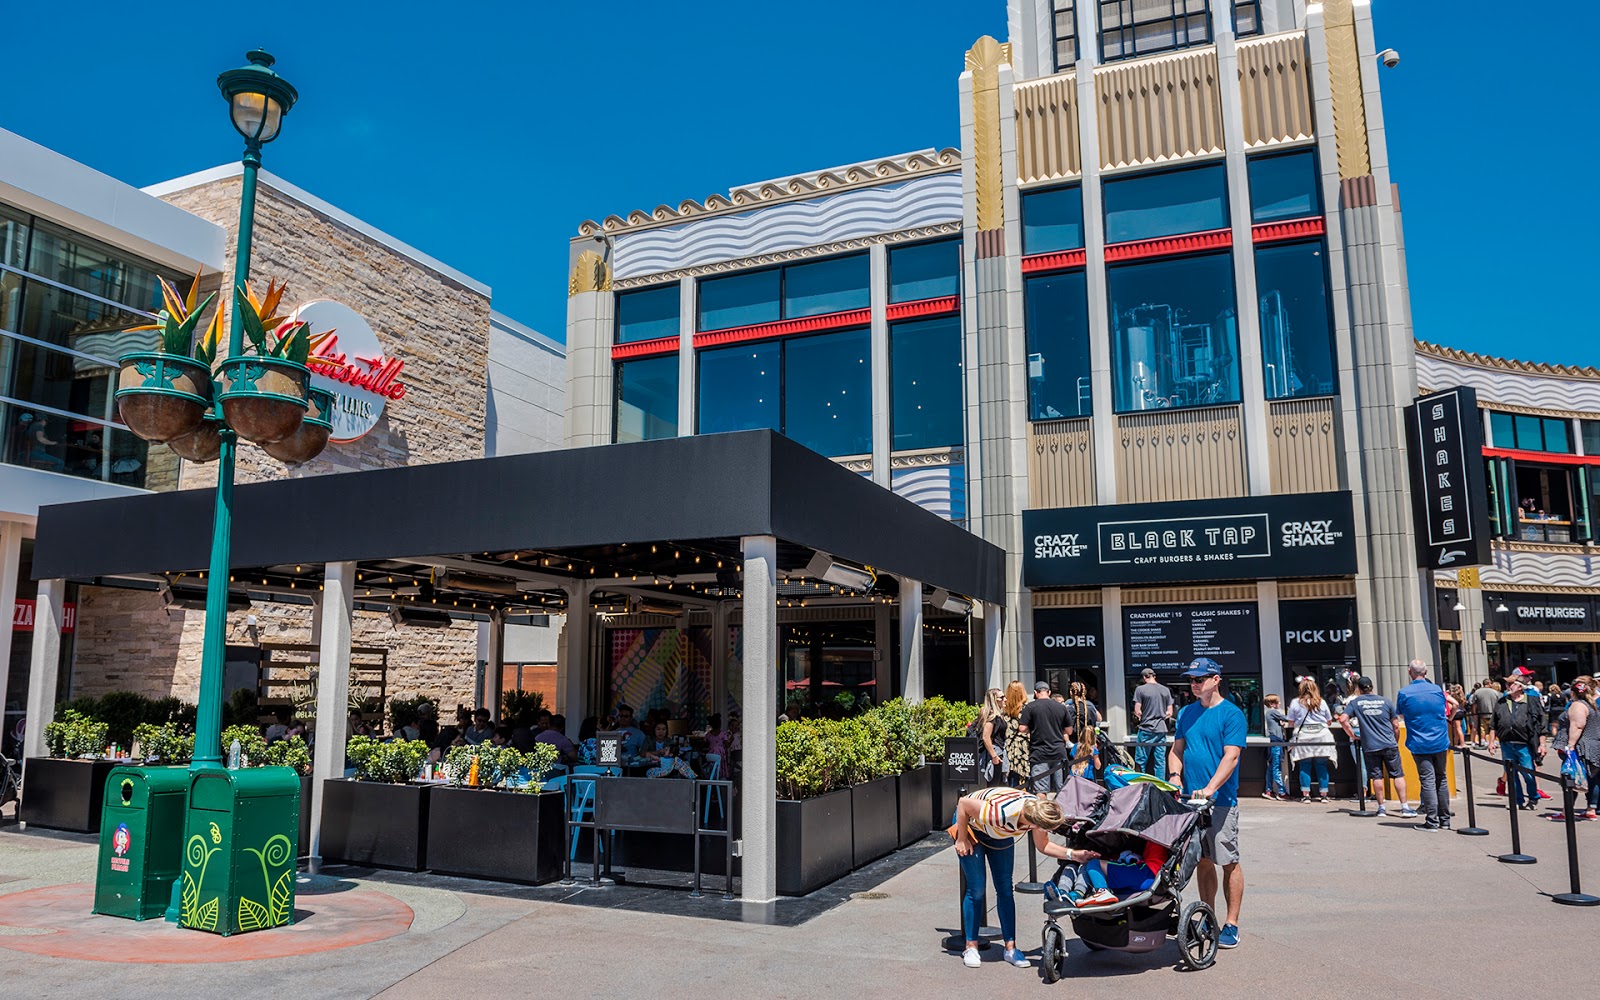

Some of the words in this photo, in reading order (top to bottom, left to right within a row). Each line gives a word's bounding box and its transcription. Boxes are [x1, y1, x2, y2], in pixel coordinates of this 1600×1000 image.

[343, 395, 372, 419] LANES
[1432, 403, 1455, 535] SHAKES
[1281, 520, 1332, 535] CRAZY
[1034, 534, 1079, 546] CRAZY
[1110, 529, 1196, 550] BLACK
[1205, 526, 1255, 546] TAP
[1133, 556, 1157, 564] CRAFT
[1159, 555, 1193, 563] BURGERS
[1204, 553, 1234, 561] SHAKES
[1517, 606, 1545, 618] CRAFT
[1545, 607, 1585, 618] BURGERS
[1043, 635, 1096, 648] ORDER
[1285, 630, 1326, 643] PICK
[1329, 629, 1353, 642] UP
[948, 758, 975, 766] SHAKES
[950, 752, 974, 760] CRAZY
